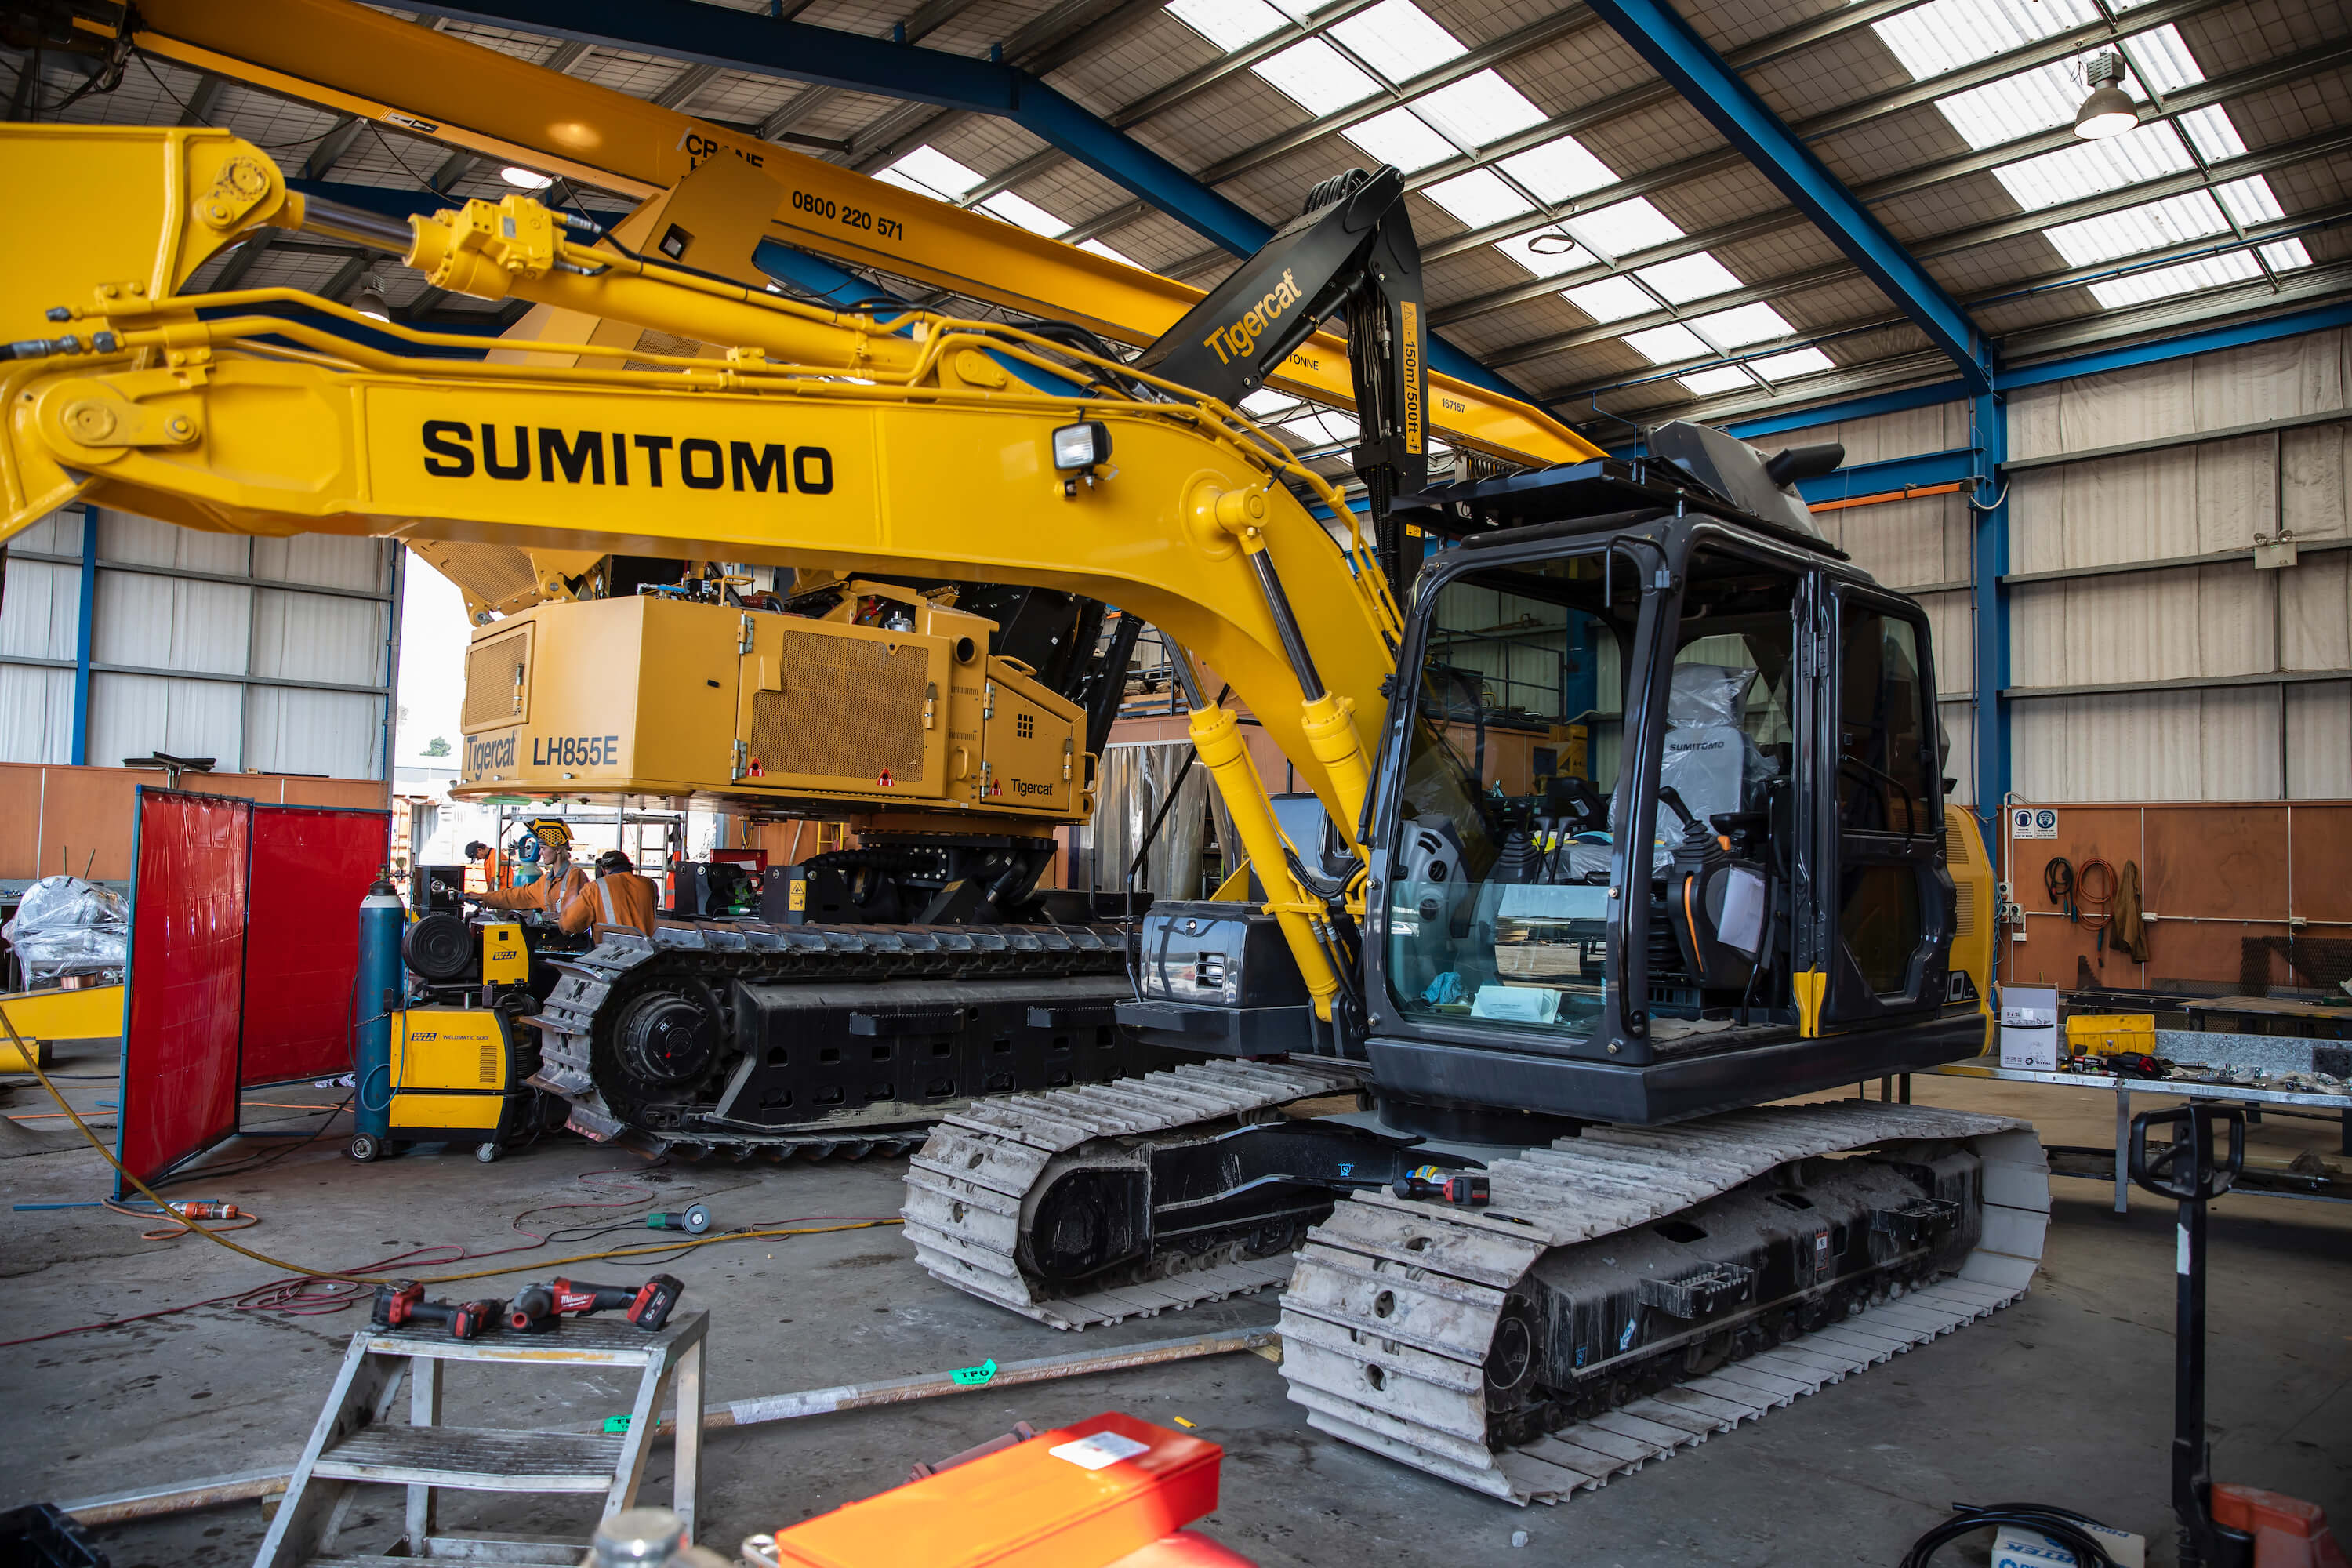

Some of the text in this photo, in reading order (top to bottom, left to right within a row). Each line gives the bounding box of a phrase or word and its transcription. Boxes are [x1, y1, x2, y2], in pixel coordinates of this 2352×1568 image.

[792, 190, 902, 241] 0800 220 571
[1203, 270, 1303, 365] Tigercat
[1289, 353, 1319, 371] TONNE
[1442, 397, 1465, 414] 167167
[422, 419, 834, 495] SUMITOMO
[466, 729, 517, 781] Tigercat
[533, 735, 619, 766] LH855E
[1669, 741, 1725, 751] SUMITOMO
[1011, 778, 1054, 797] Tigercat
